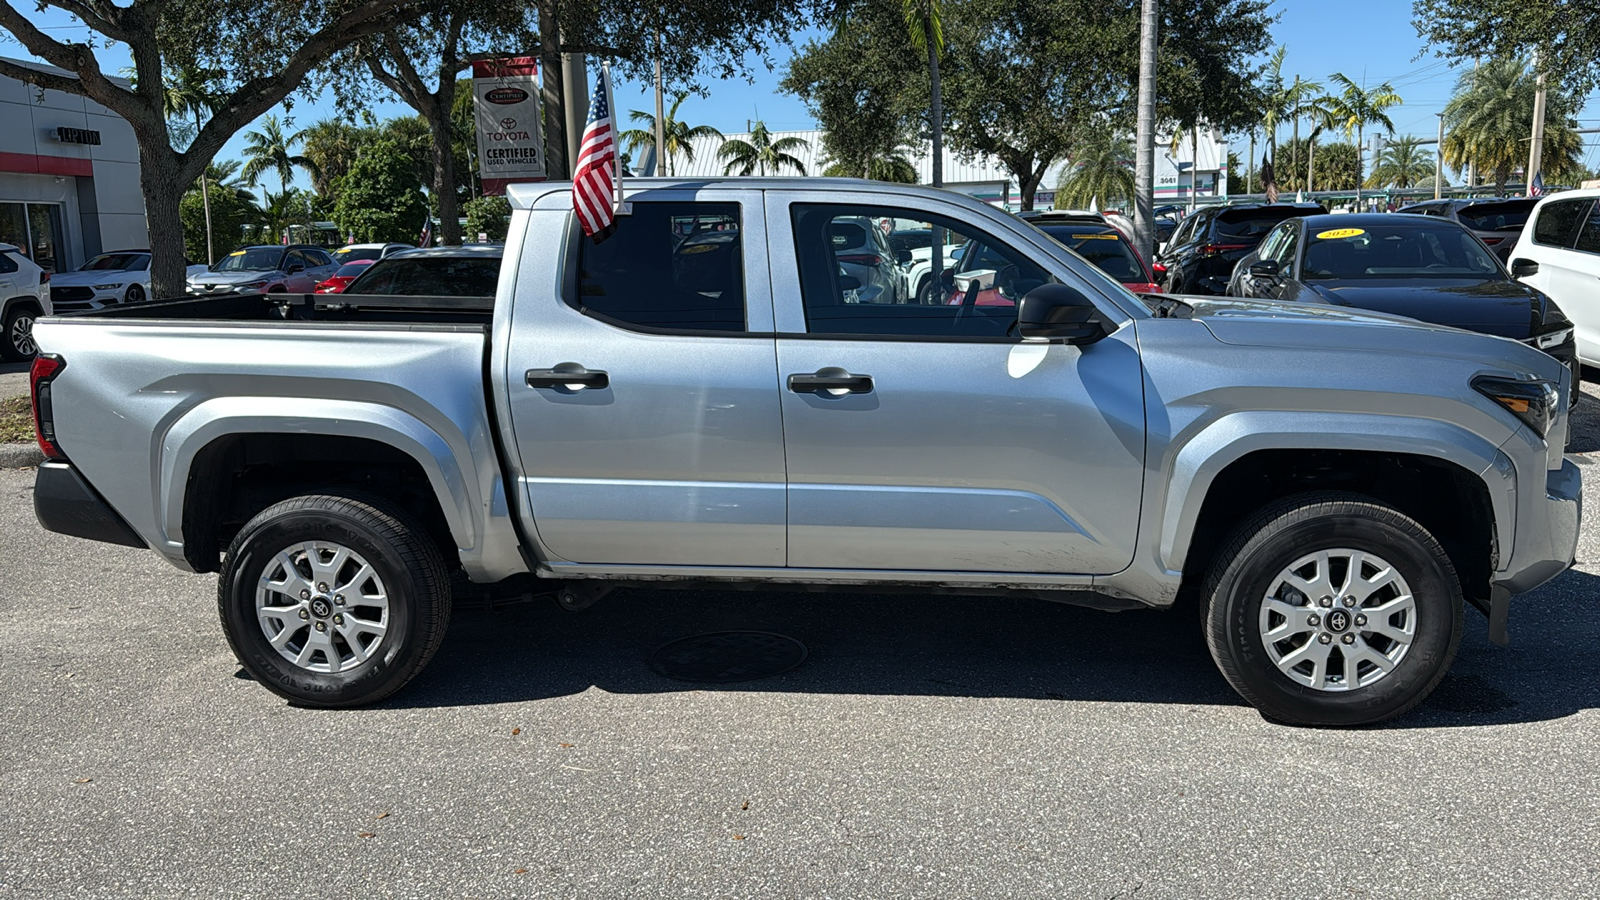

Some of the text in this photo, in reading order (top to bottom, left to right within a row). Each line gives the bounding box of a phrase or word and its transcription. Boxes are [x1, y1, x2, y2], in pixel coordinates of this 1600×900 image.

[59, 127, 101, 145] LIPTON
[486, 131, 530, 141] TOYOTA
[486, 148, 536, 159] CERTIFIED
[1325, 229, 1355, 238] 2023
